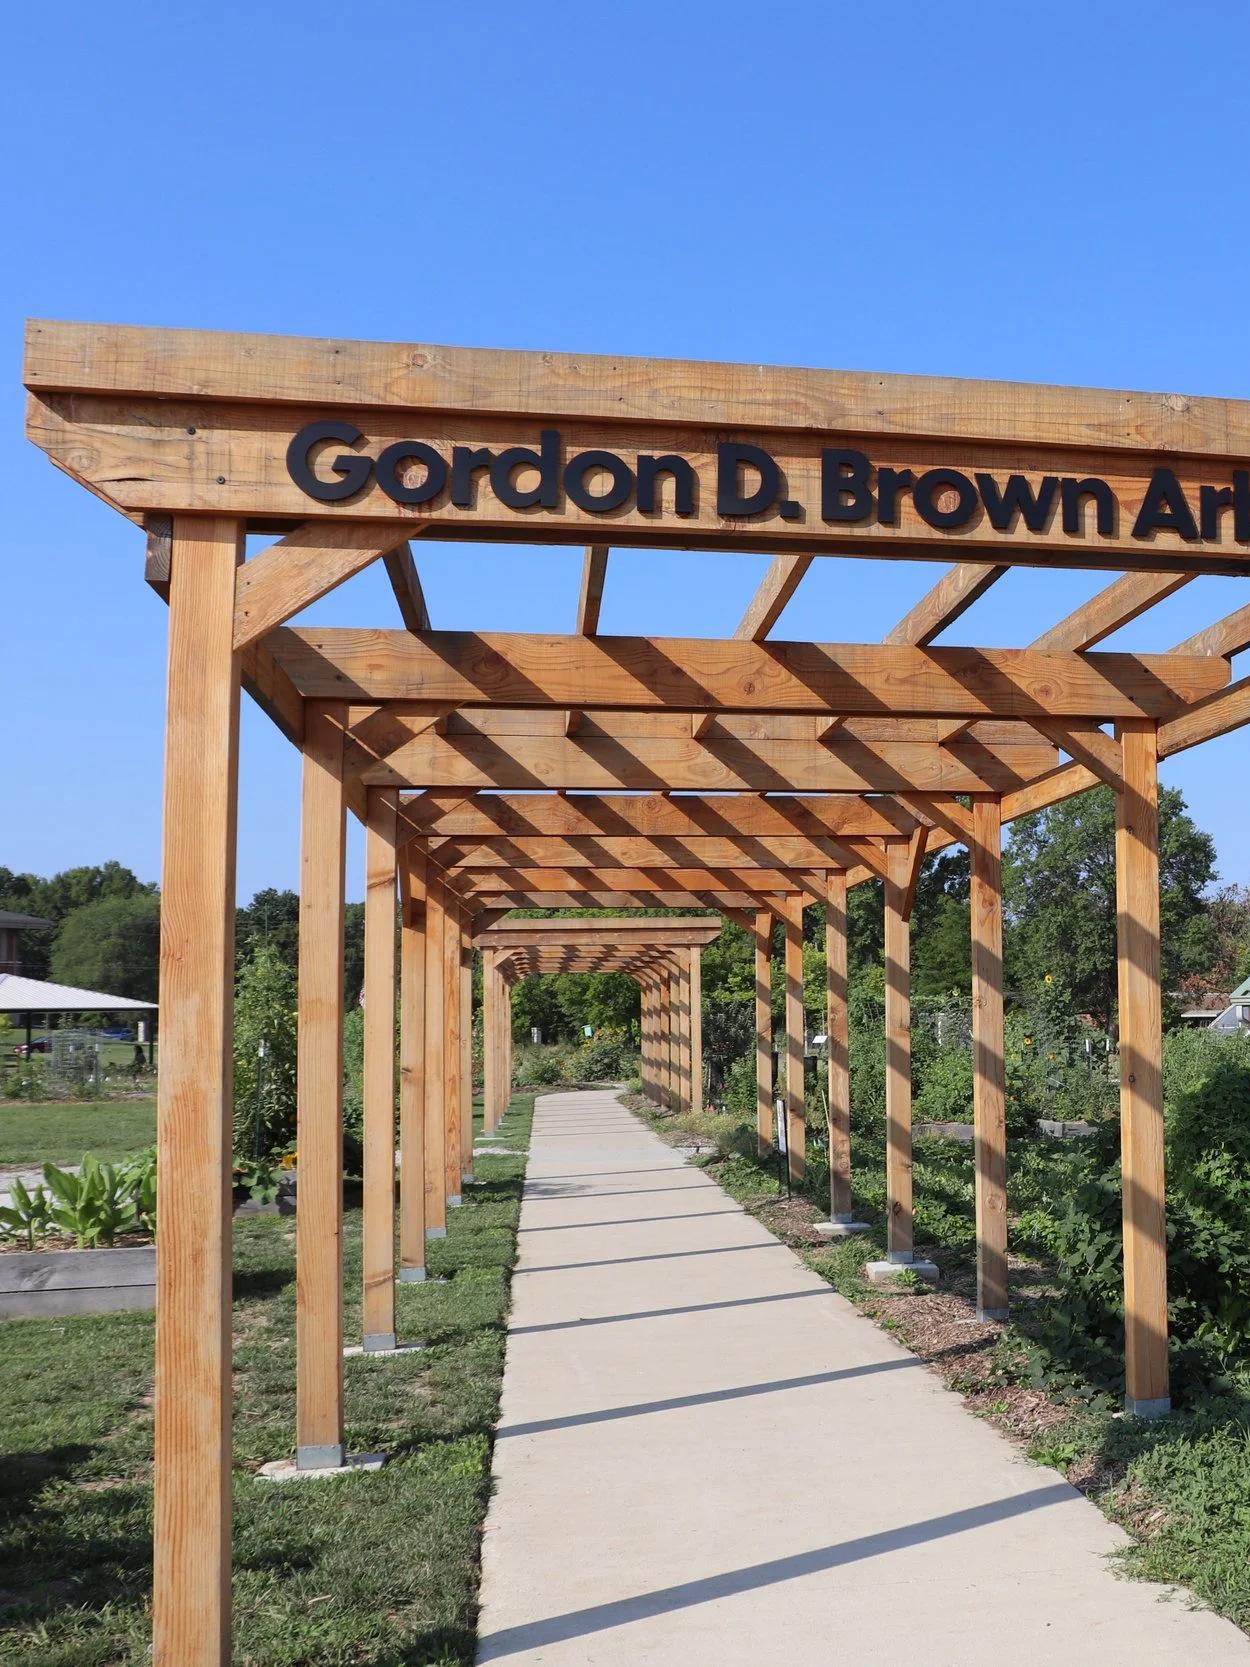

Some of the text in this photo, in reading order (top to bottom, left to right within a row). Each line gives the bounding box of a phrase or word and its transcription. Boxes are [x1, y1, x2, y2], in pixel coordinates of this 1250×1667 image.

[286, 420, 695, 513] Gordon
[717, 442, 800, 518] D.
[821, 448, 1113, 534] Brown
